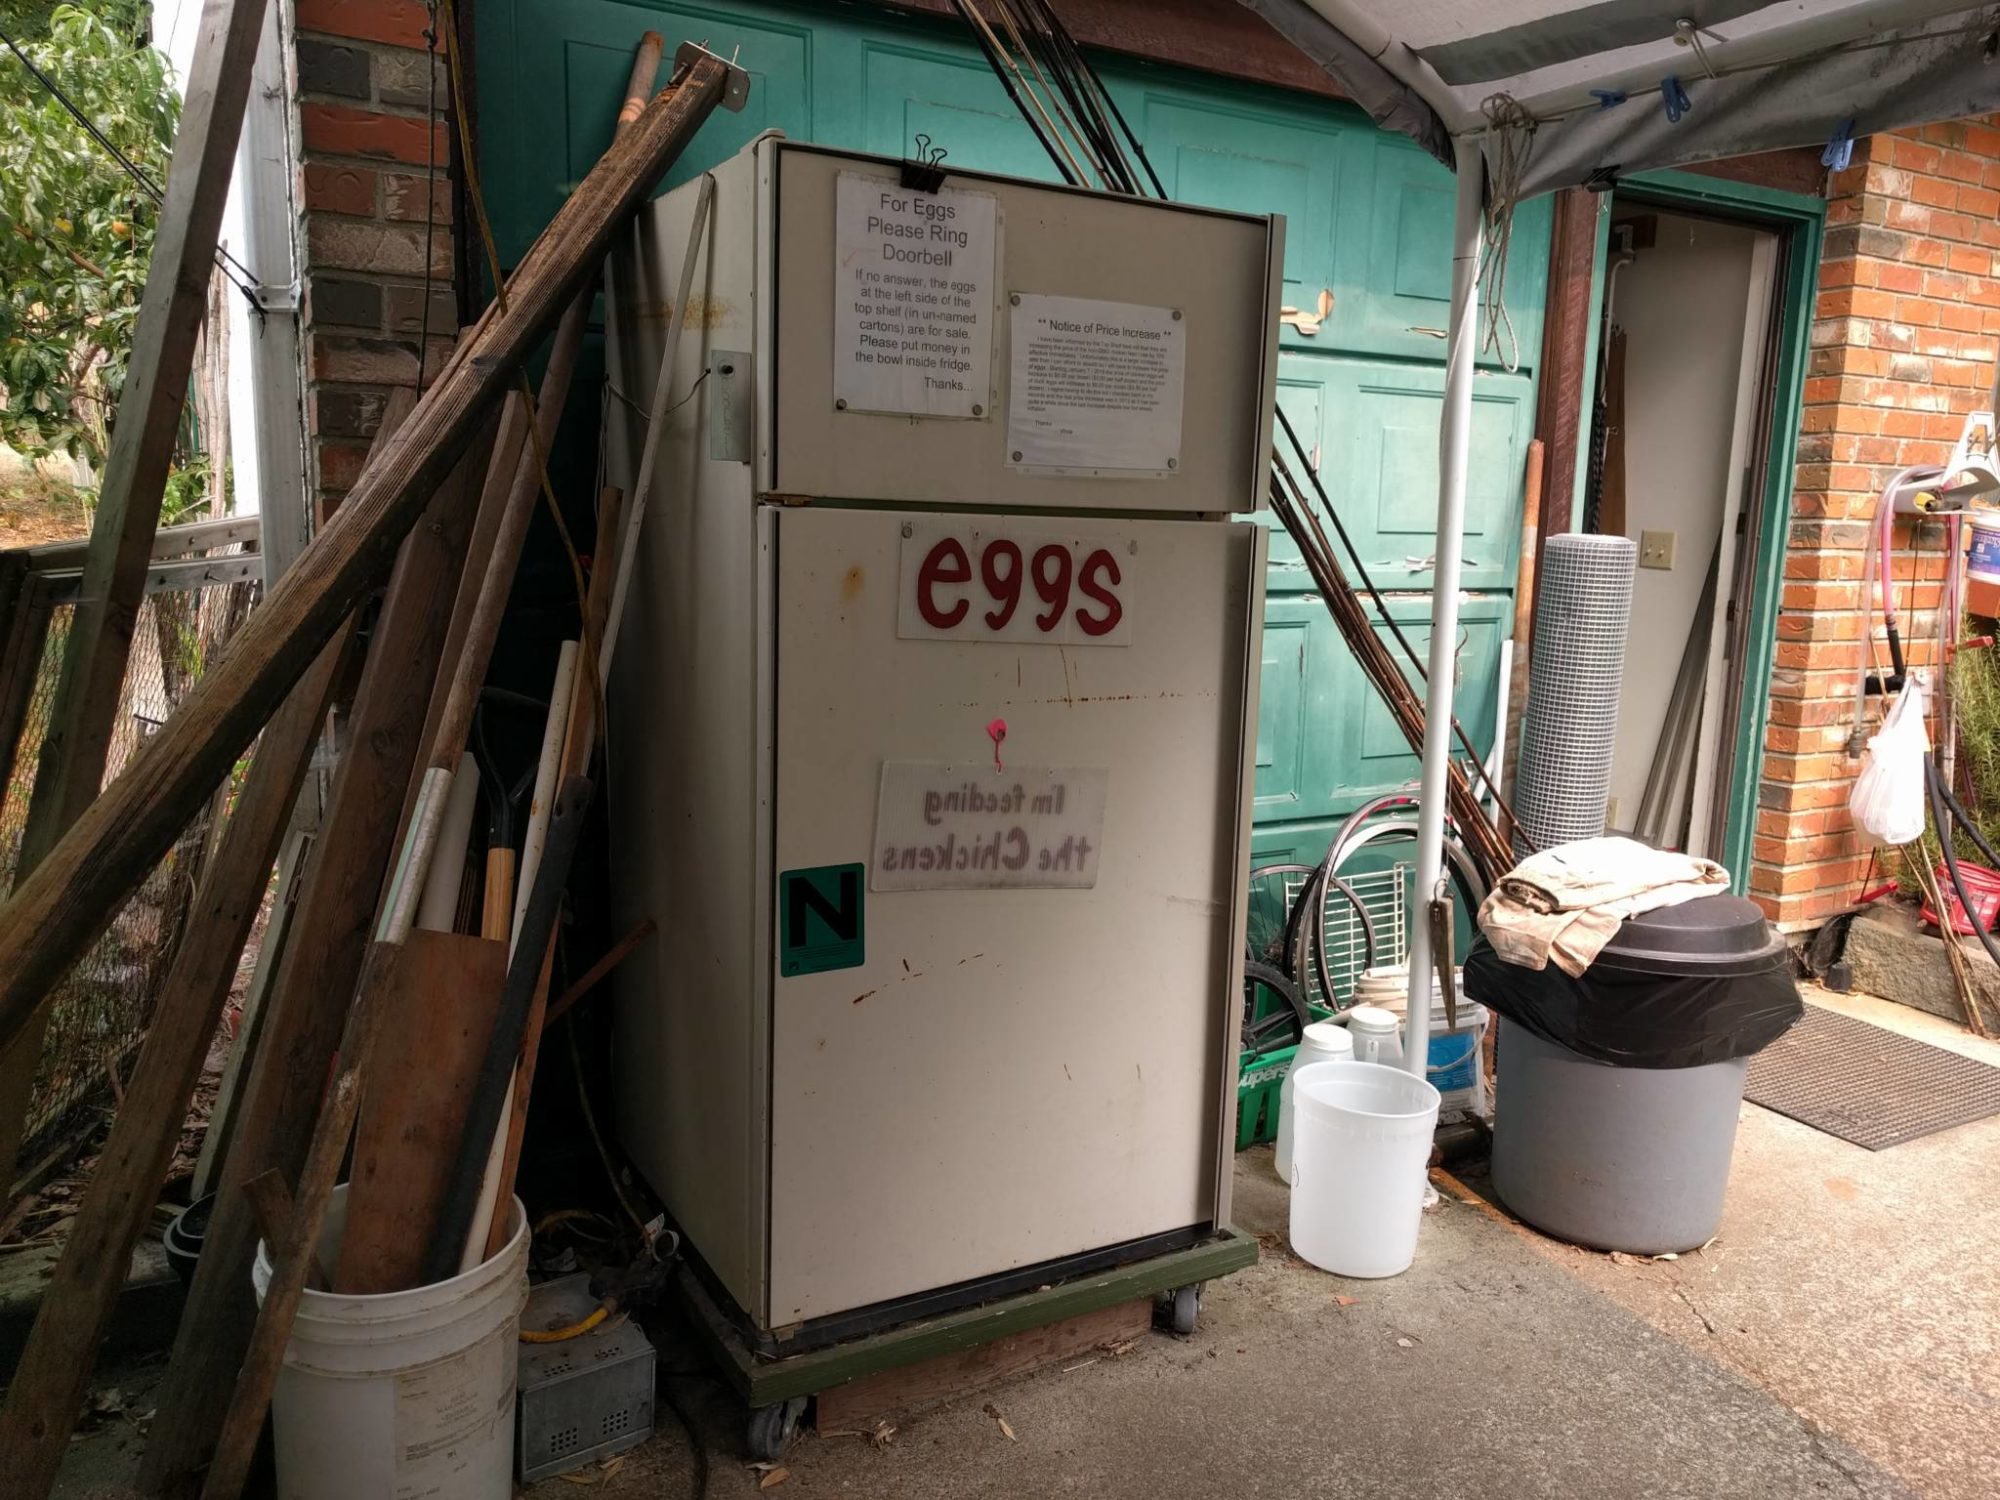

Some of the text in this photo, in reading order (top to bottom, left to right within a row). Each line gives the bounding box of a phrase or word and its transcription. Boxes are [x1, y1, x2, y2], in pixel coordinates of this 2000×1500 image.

[881, 193, 956, 221] For Eggs
[868, 216, 968, 248] Please Ring
[883, 243, 952, 267] Doorbell
[856, 269, 977, 295] If no answer, the eggs
[860, 288, 971, 308] at the left side of the
[854, 302, 977, 324] top shelf (in un-named
[859, 320, 972, 340] cartons) are for sale.
[1050, 319, 1161, 341] Notice of Price Increase
[860, 334, 970, 356] Please put money in
[855, 351, 973, 373] the bowl inside fridge.
[924, 376, 975, 391] Thanks...
[917, 537, 1123, 636] eggs
[788, 870, 857, 949] N
